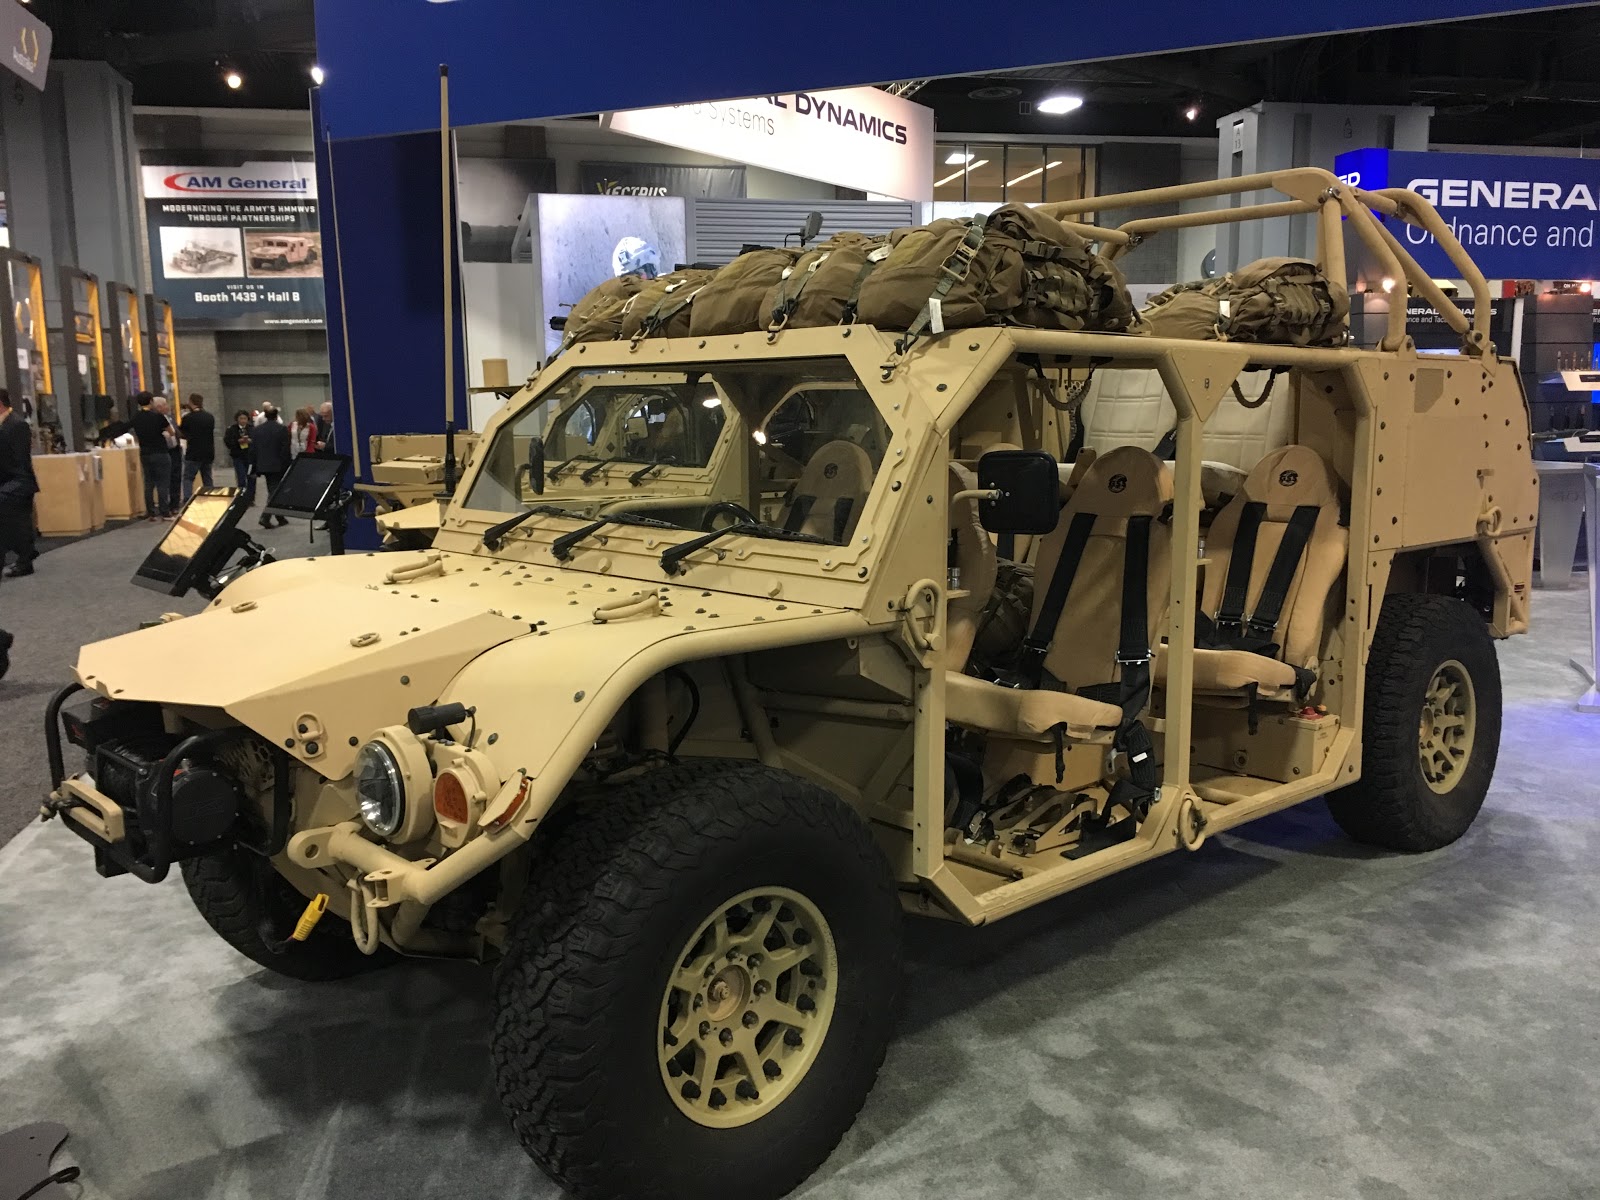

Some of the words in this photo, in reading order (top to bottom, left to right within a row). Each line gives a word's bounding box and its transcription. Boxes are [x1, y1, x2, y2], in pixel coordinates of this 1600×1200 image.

[795, 93, 907, 145] DYNAMICS
[187, 176, 222, 188] AM
[227, 177, 308, 189] General
[1406, 178, 1600, 211] GENERA
[162, 204, 222, 213] MODERNIZING
[224, 204, 242, 213] THE
[243, 204, 276, 213] ARMY'S
[187, 213, 229, 222] THROUGH
[230, 214, 296, 223] PARTNERSHIPS
[1546, 219, 1594, 248] and
[194, 291, 229, 302] Booth
[230, 291, 257, 302] 1439
[267, 291, 290, 302] Hall
[292, 292, 300, 302] B
[1406, 307, 1440, 315] NERAL
